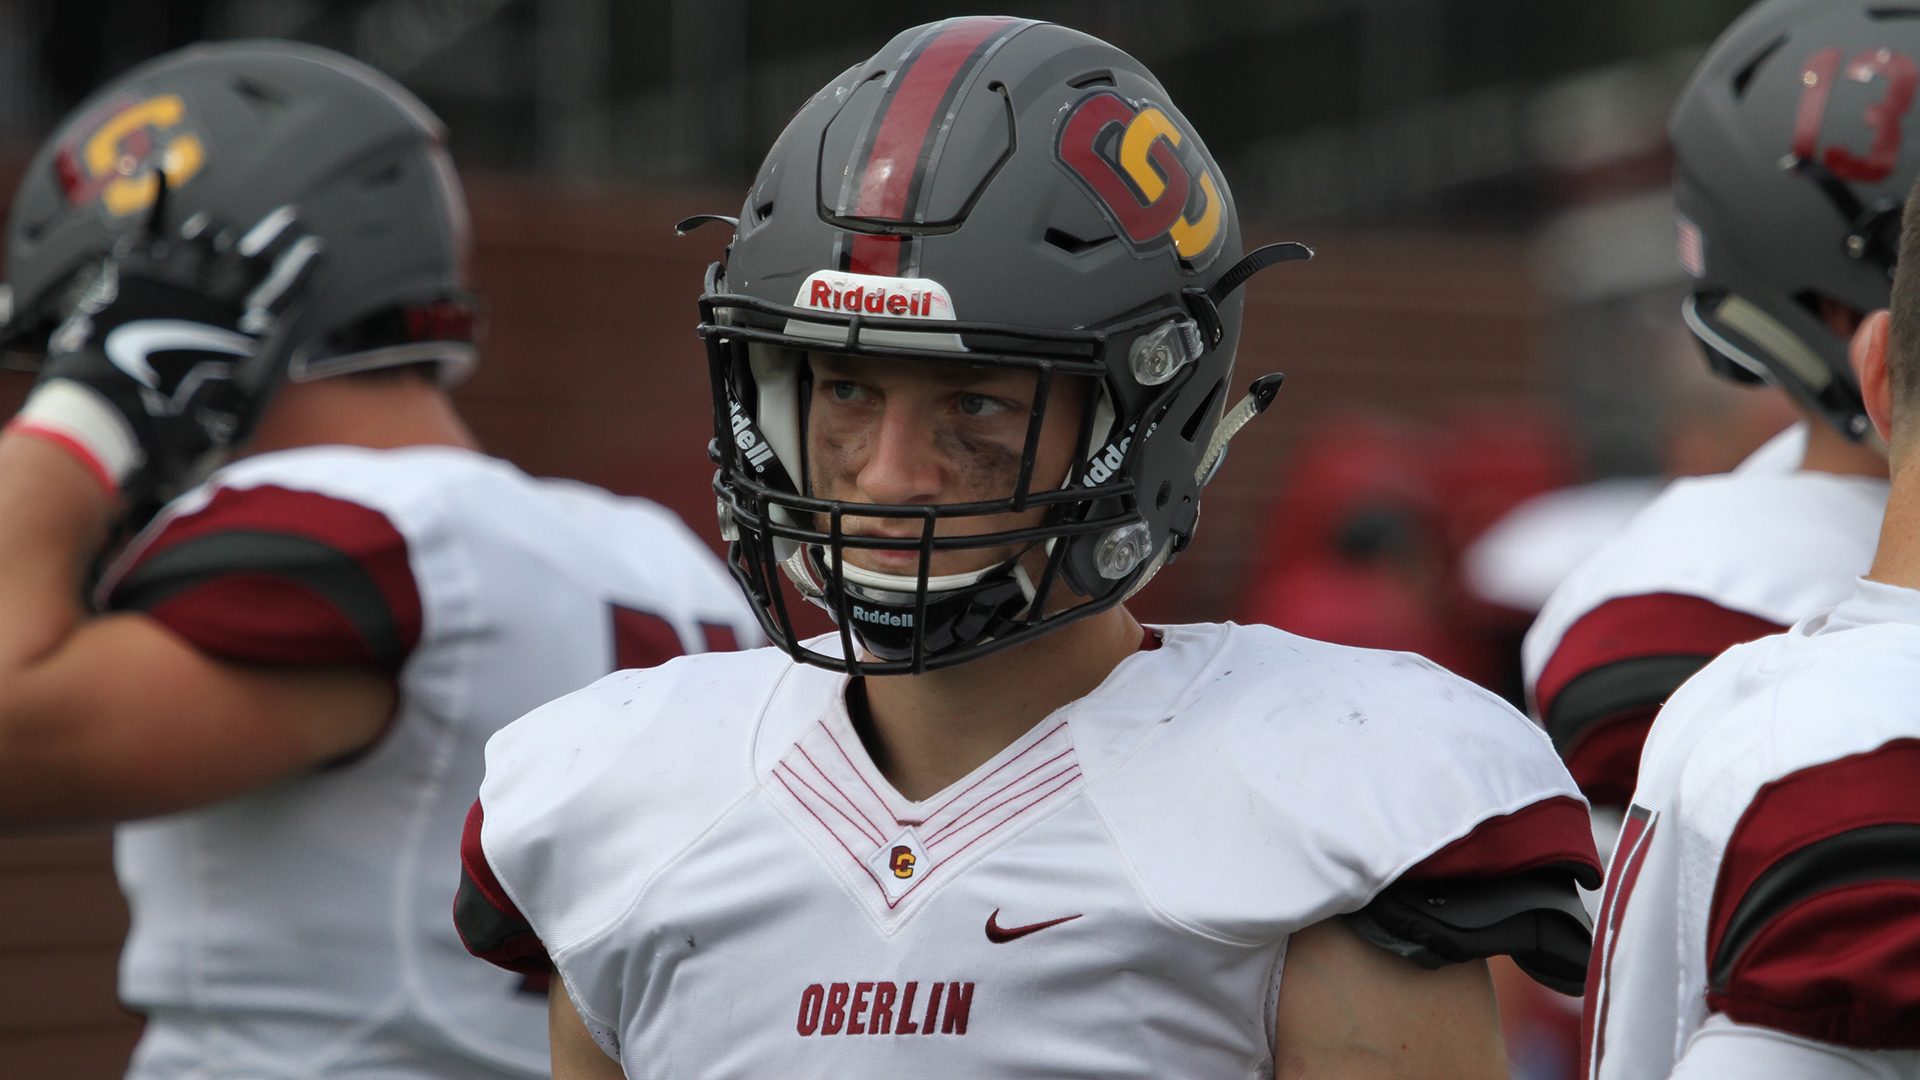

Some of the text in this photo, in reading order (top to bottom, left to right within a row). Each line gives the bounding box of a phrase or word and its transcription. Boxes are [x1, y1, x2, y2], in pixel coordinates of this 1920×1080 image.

[809, 279, 933, 317] Riddell
[852, 605, 914, 628] Riddell
[796, 981, 976, 1037] OBERLIN
